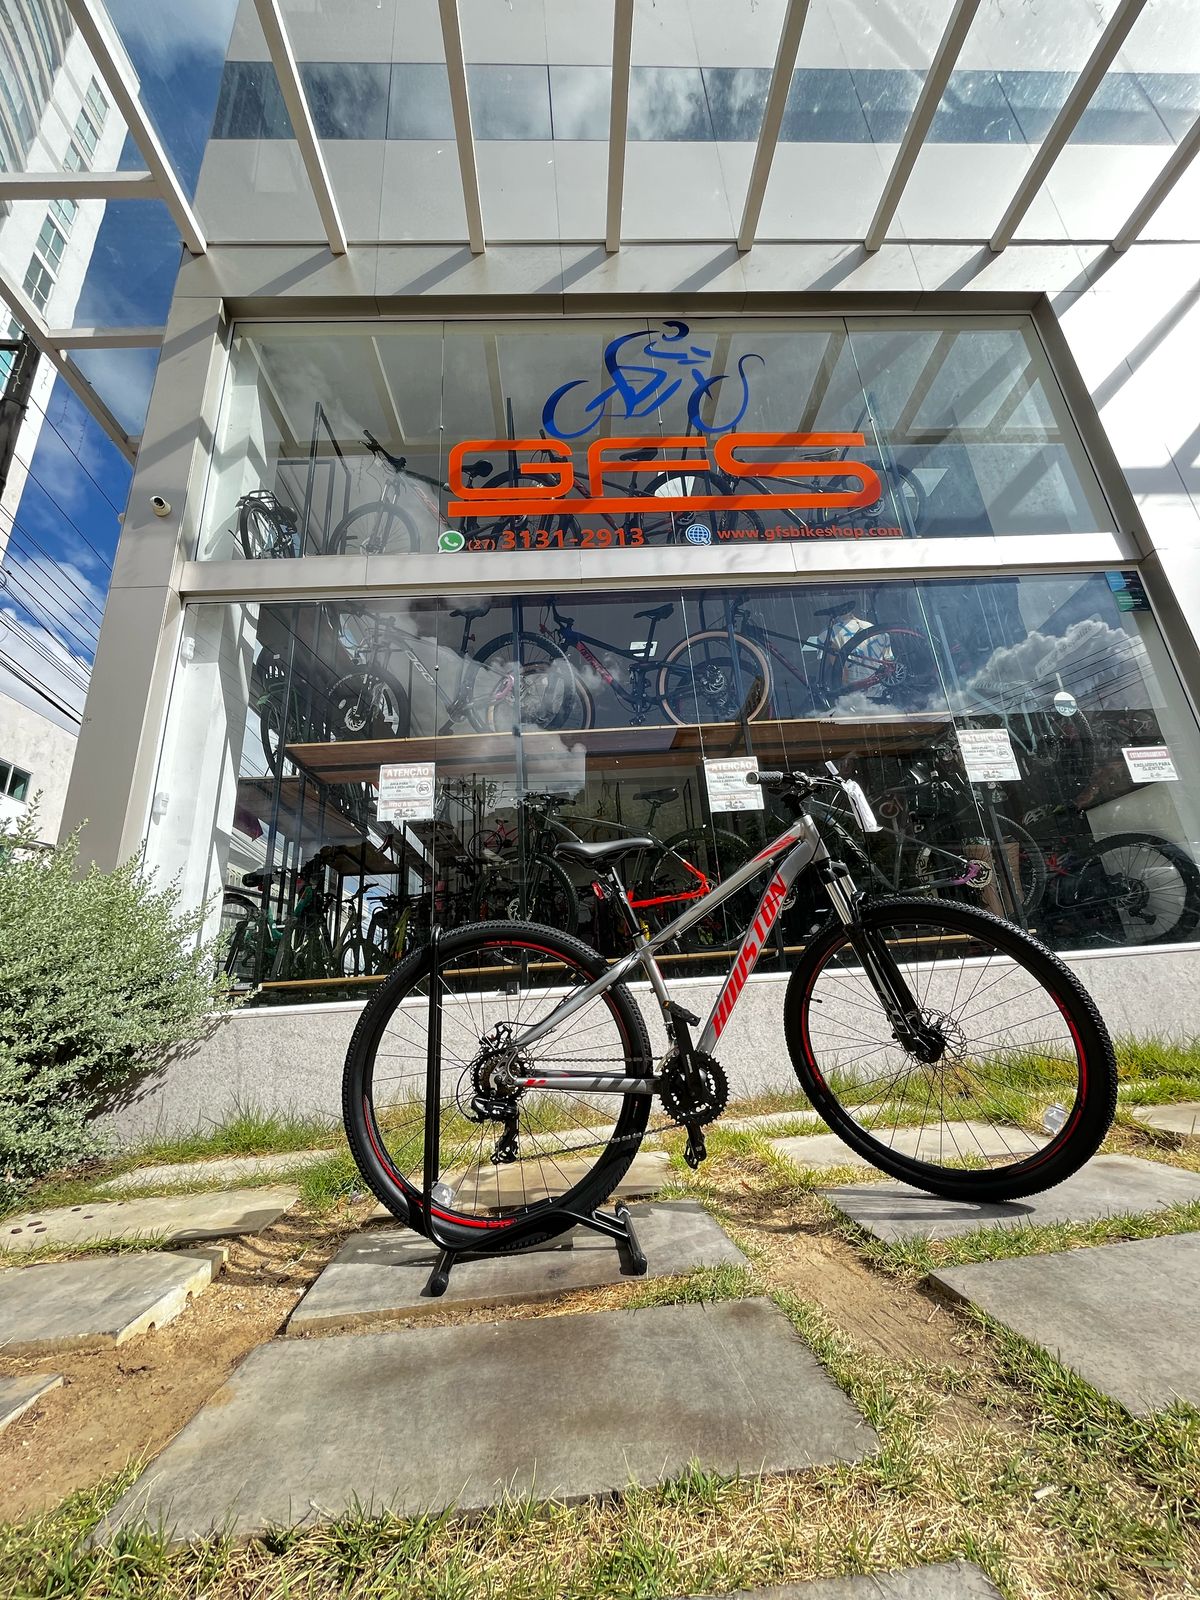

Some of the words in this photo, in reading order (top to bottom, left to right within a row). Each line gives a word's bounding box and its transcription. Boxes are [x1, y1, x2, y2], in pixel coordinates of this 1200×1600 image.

[447, 432, 882, 518] GFS
[467, 538, 496, 551] (27)
[501, 527, 645, 550] 3131-2913
[717, 524, 904, 541] www.gfsbikeshop.com
[711, 871, 787, 1040] HOUSTON
